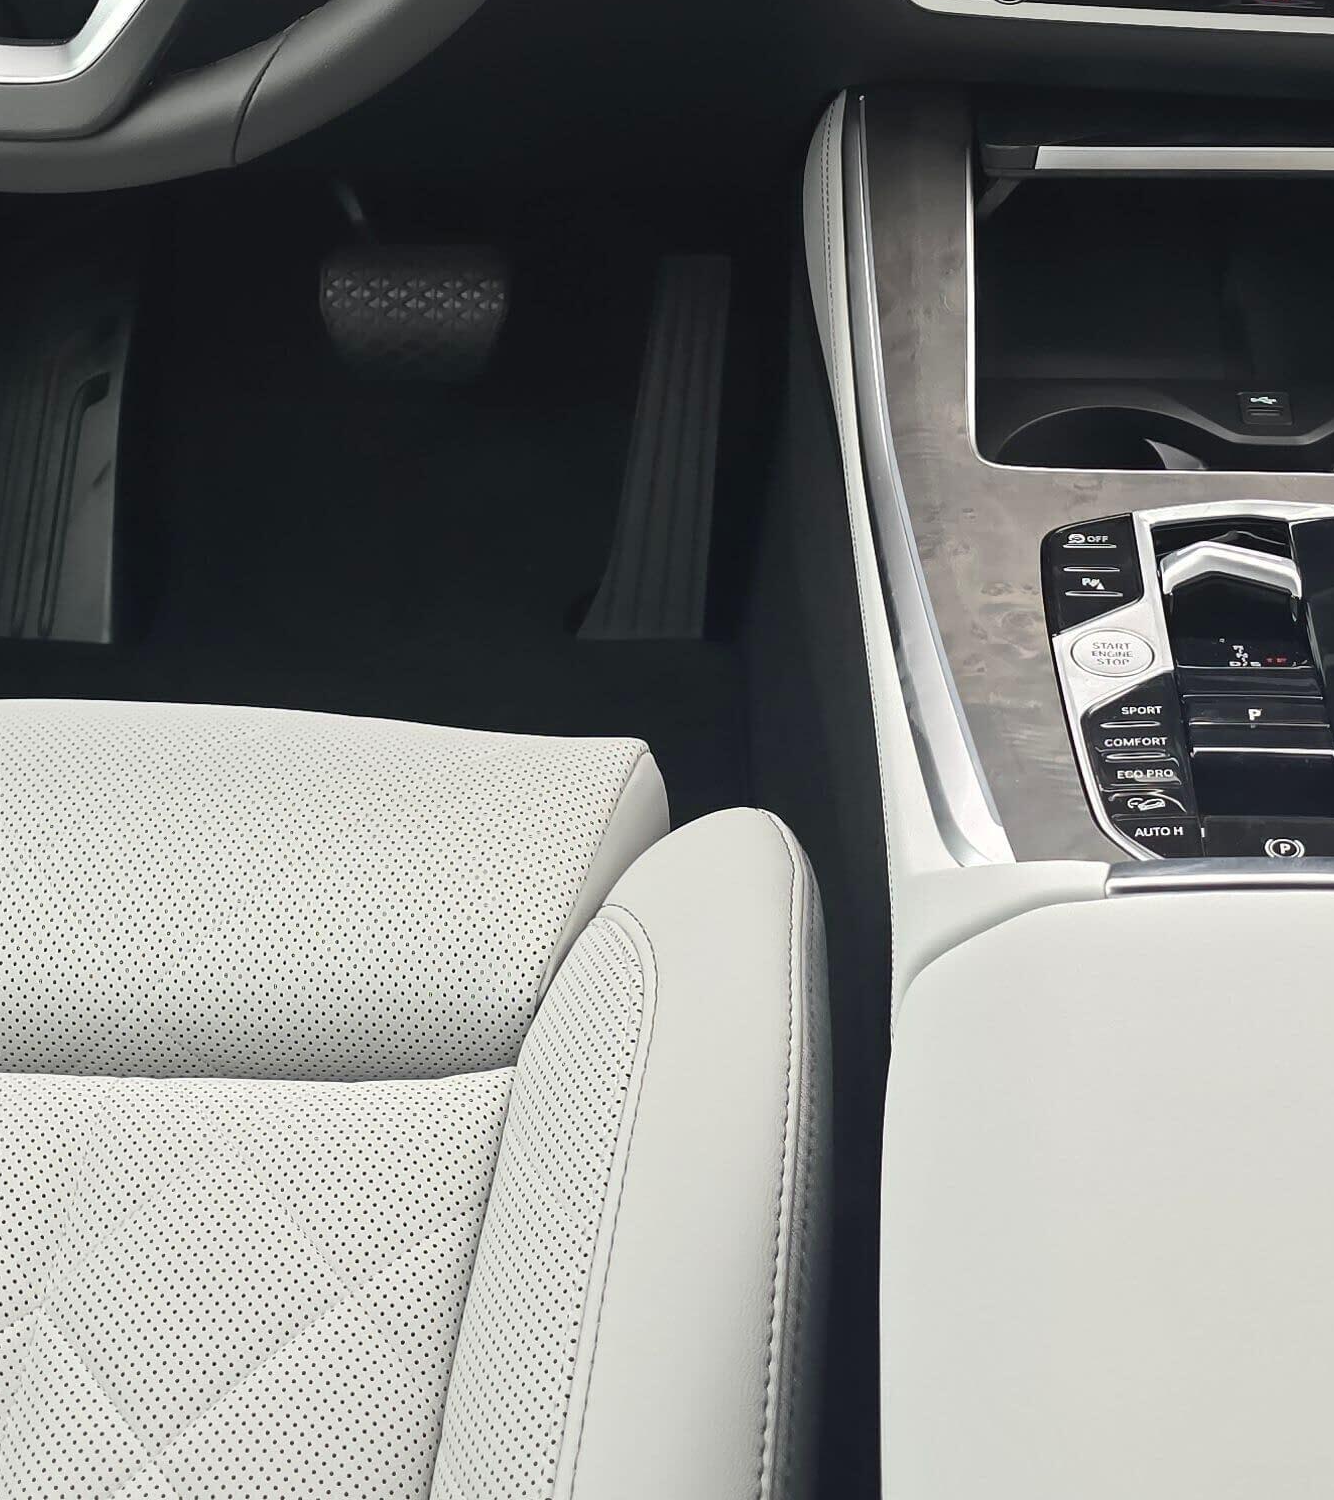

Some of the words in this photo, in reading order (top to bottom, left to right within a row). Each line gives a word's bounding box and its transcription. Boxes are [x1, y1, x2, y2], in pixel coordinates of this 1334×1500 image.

[1087, 535, 1108, 543] OFF
[1092, 642, 1131, 650] START
[1091, 650, 1134, 658] ENGINE
[1096, 658, 1130, 666] STOP
[1121, 705, 1163, 715] SPORT
[1248, 708, 1262, 721] P
[1104, 737, 1167, 747] COMFORT
[1117, 770, 1143, 779] ECO
[1147, 769, 1173, 778] PRO
[1134, 826, 1171, 837] AUTO
[1173, 826, 1184, 836] H
